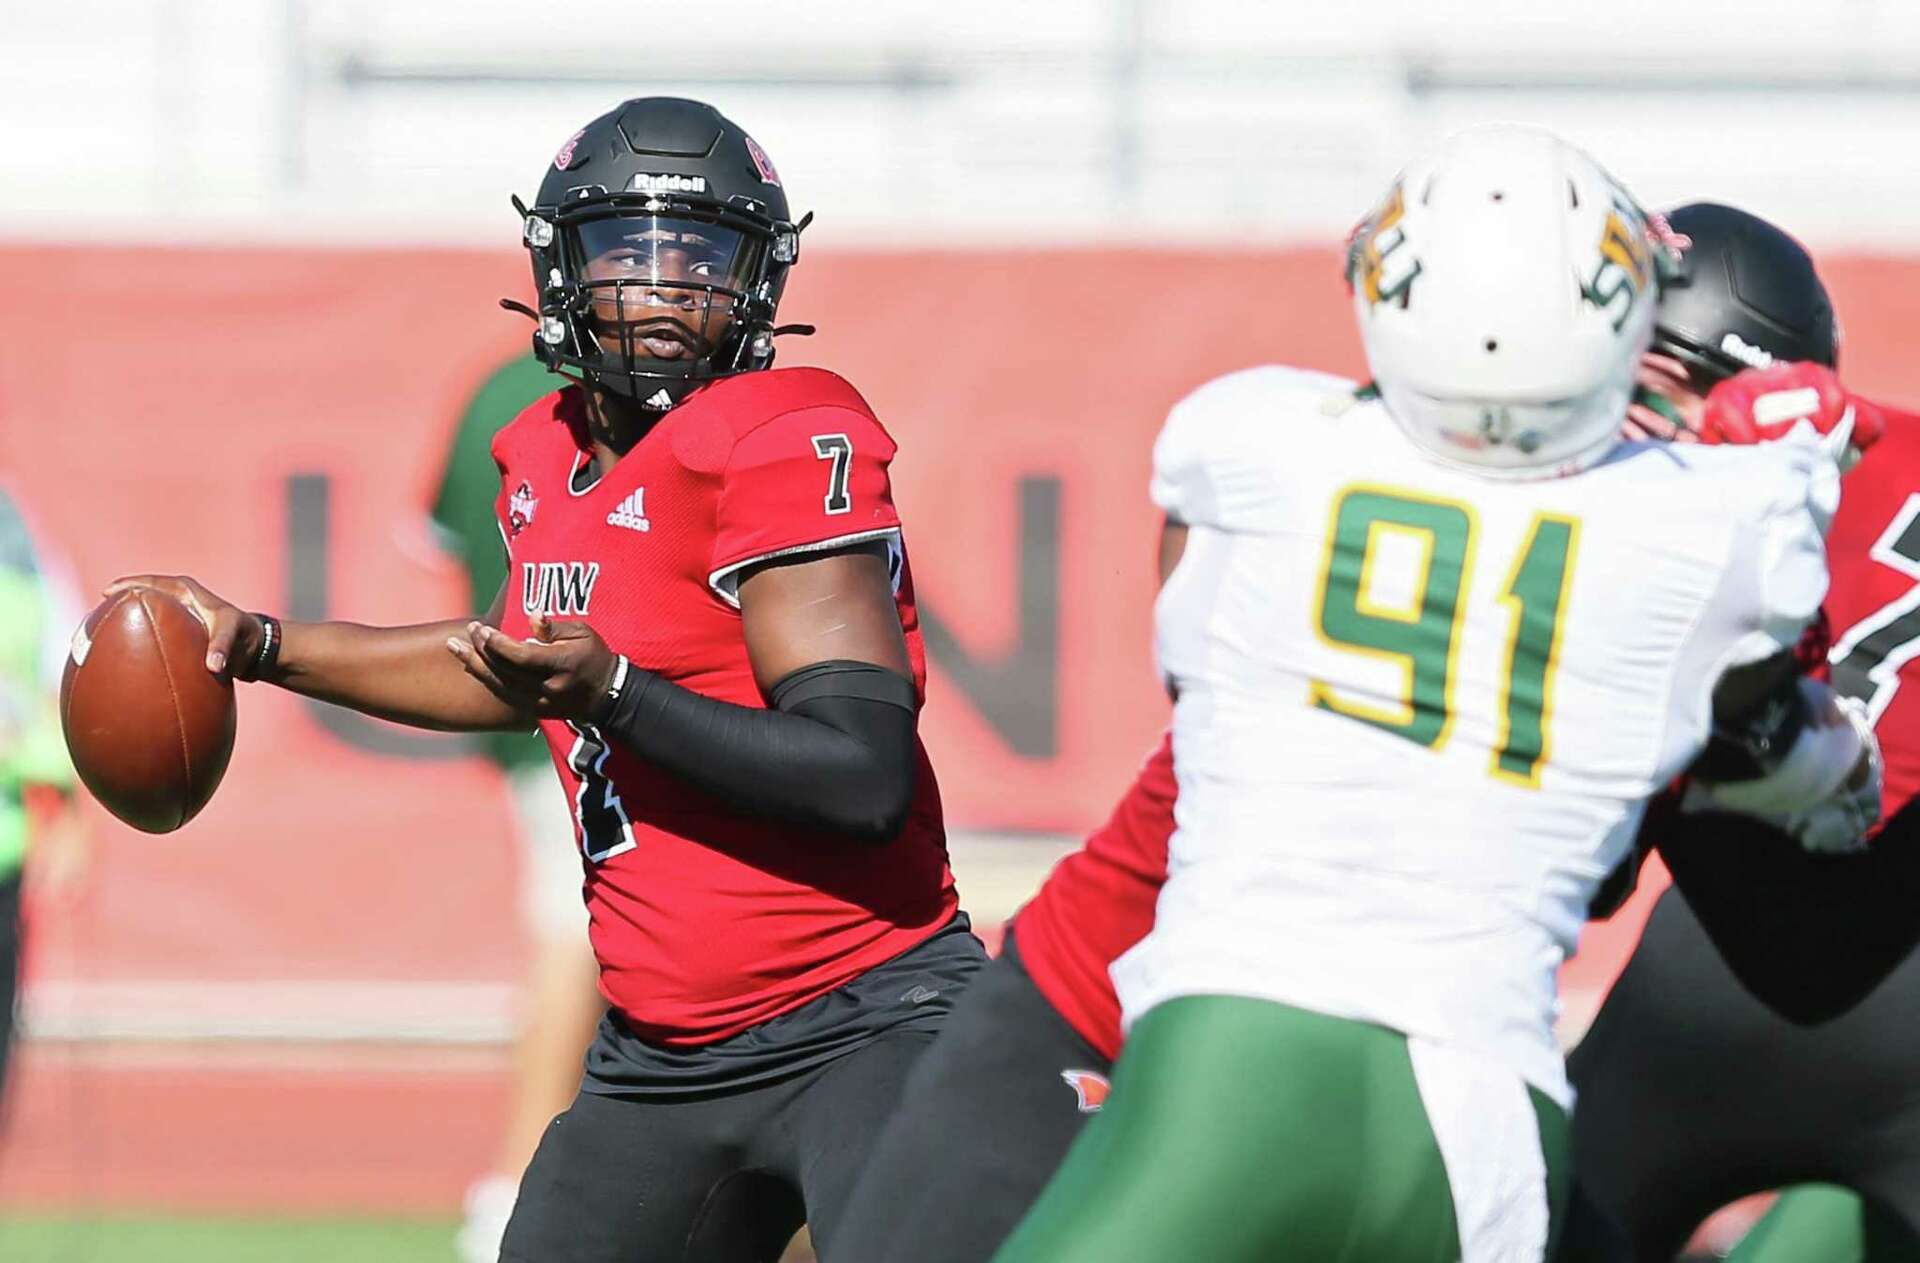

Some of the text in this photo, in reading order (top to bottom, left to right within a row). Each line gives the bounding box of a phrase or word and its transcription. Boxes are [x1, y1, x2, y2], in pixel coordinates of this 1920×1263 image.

[634, 173, 705, 193] Riddell
[810, 432, 853, 516] 7
[606, 512, 650, 532] adidas
[522, 561, 600, 617] UIW
[1306, 482, 1582, 790] 91
